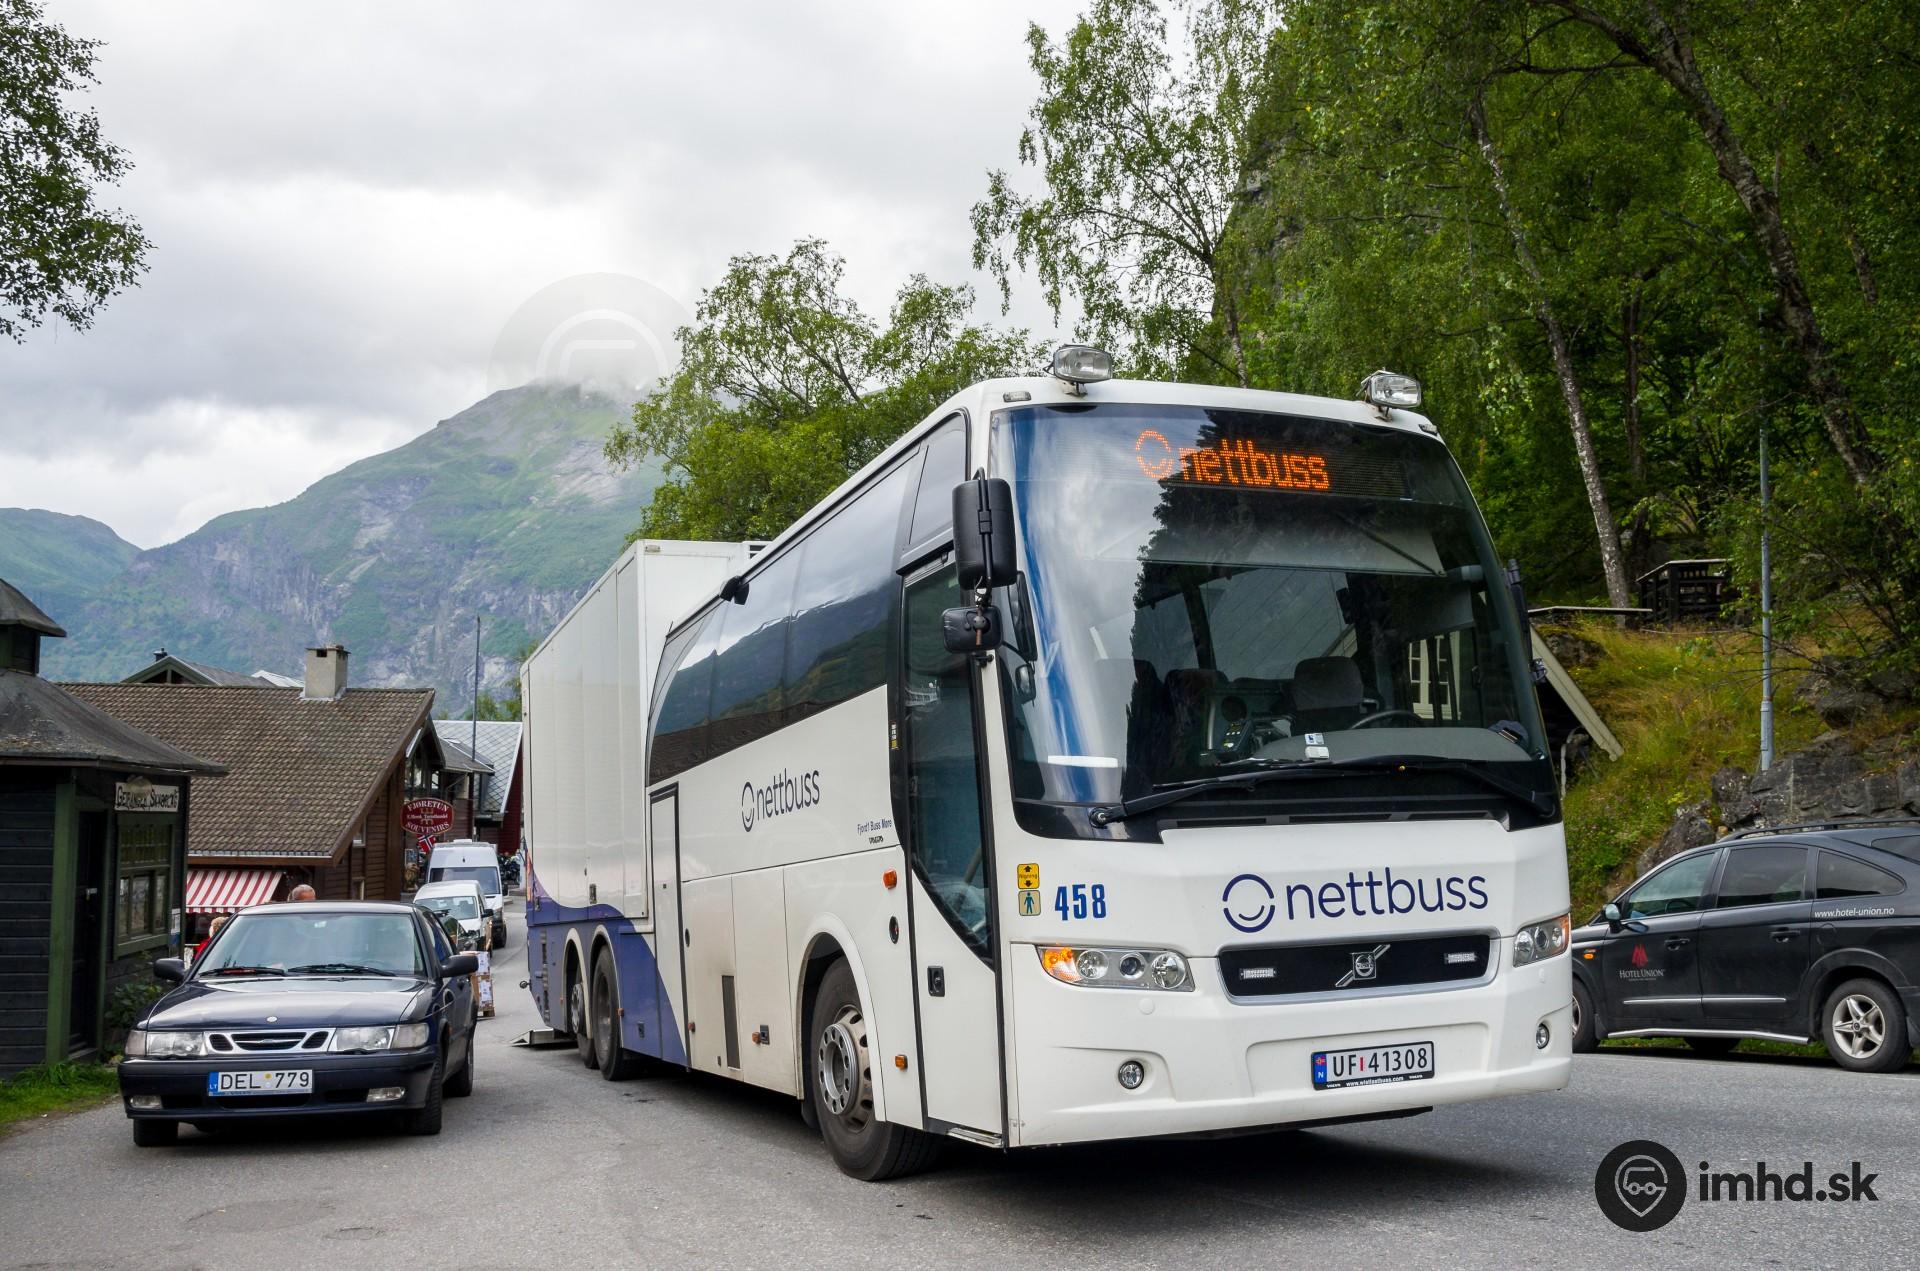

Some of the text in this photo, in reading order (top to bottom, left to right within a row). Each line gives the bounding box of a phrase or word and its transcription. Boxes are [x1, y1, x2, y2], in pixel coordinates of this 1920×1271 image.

[1178, 438, 1330, 490] nettbuss
[756, 767, 821, 822] nettbuss
[405, 821, 449, 834] SOUVENIRS
[1054, 883, 1107, 921] 458
[1285, 866, 1490, 921] nettbuss
[1814, 906, 1895, 918] www.hotel-union.no
[1318, 1071, 1325, 1079] N
[1332, 1047, 1428, 1078] UF 41308
[221, 1071, 310, 1090] DEL 779
